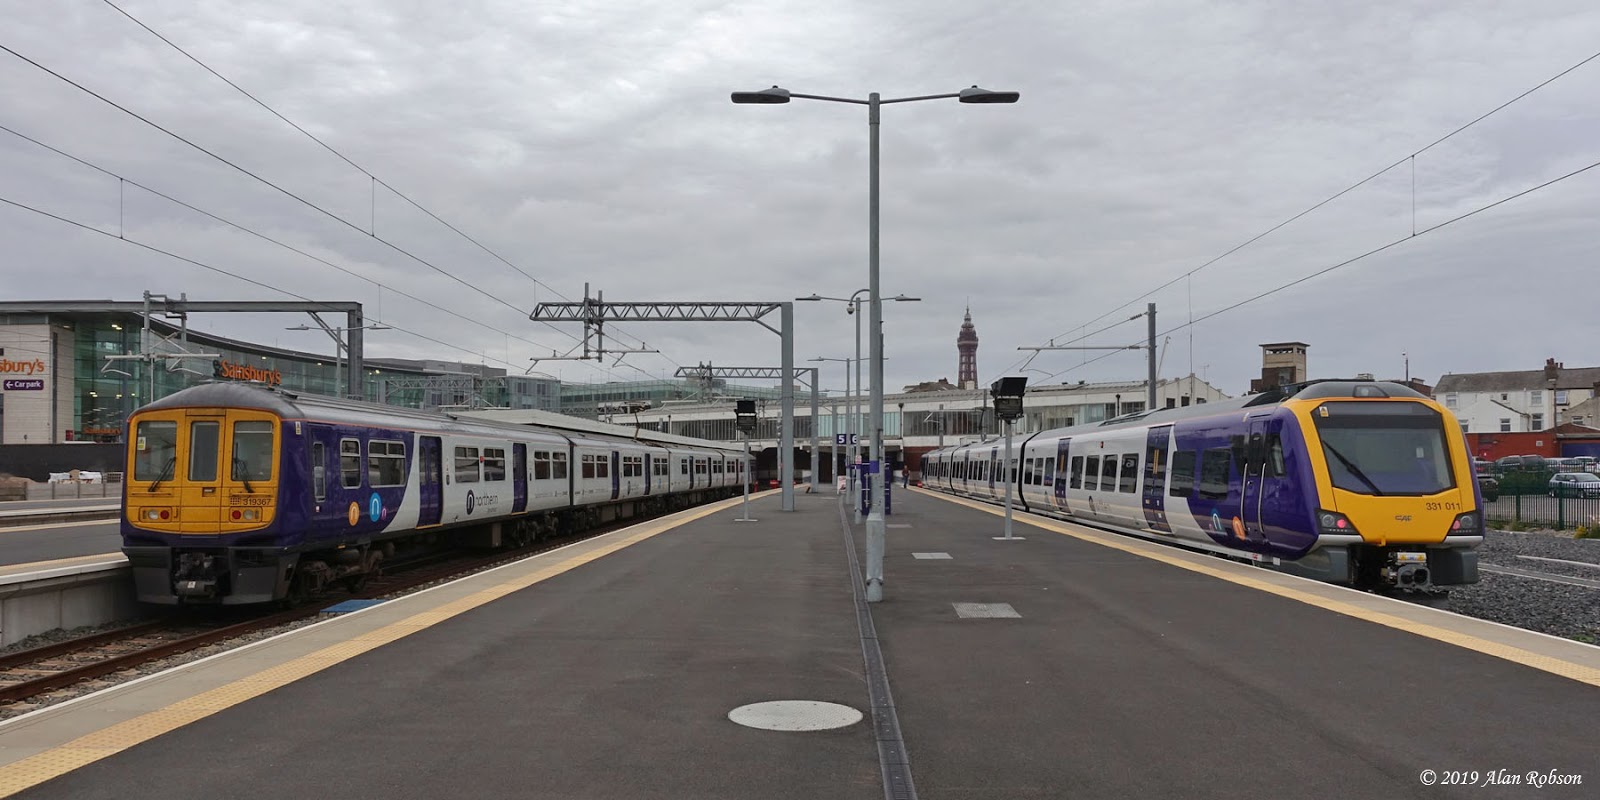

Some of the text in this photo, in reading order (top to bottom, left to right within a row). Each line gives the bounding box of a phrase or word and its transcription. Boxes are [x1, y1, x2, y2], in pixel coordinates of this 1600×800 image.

[221, 360, 282, 387] Sainsbury's
[838, 434, 845, 444] 5
[1425, 502, 1461, 510] 331 011
